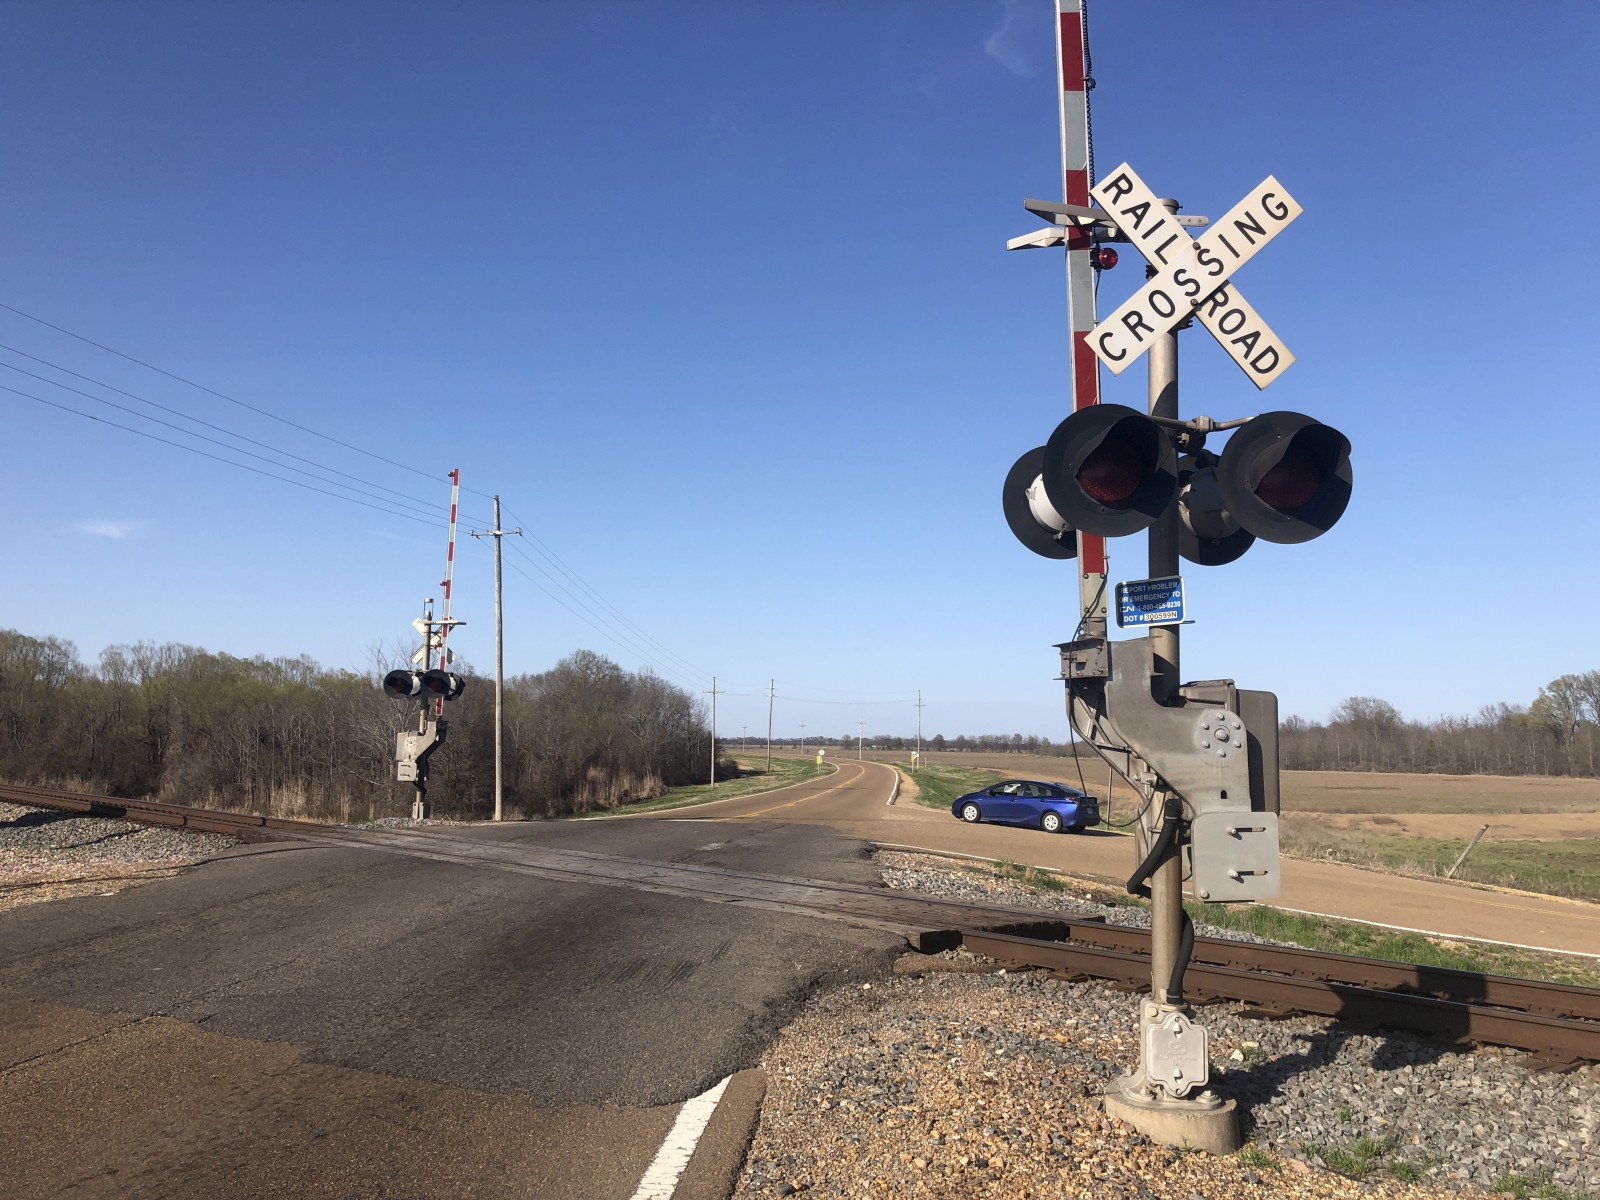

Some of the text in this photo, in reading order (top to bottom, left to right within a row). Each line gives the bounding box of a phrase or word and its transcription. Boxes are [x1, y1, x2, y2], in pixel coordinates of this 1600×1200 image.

[1098, 192, 1289, 362] CROSSING
[1102, 172, 1279, 375] RAIL ROAD
[1120, 582, 1178, 594] REPORT PROBLEM
[1130, 592, 1170, 602] EMERGENCY
[1145, 612, 1176, 620] 300599N
